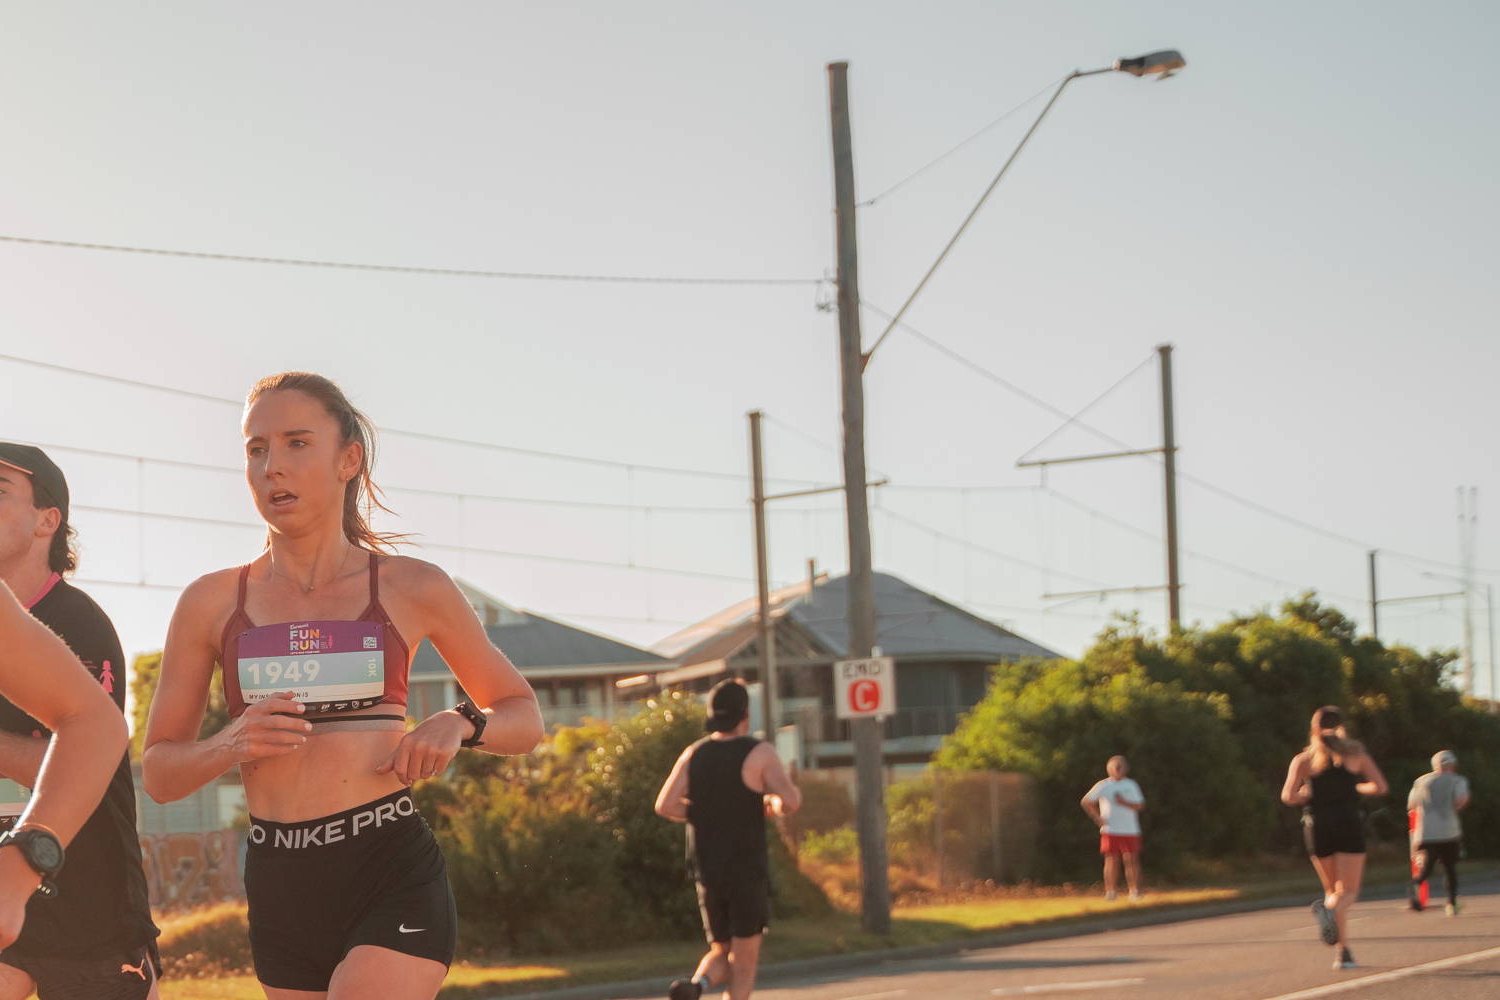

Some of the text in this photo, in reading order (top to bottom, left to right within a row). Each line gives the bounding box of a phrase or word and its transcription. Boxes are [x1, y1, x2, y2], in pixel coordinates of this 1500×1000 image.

[289, 629, 320, 640] FUN
[289, 639, 320, 651] RUN
[247, 659, 320, 685] 1949
[367, 659, 377, 678] 10K
[843, 661, 881, 678] END
[855, 682, 875, 709] C
[274, 819, 346, 849] NIKE
[352, 795, 414, 836] PRO
